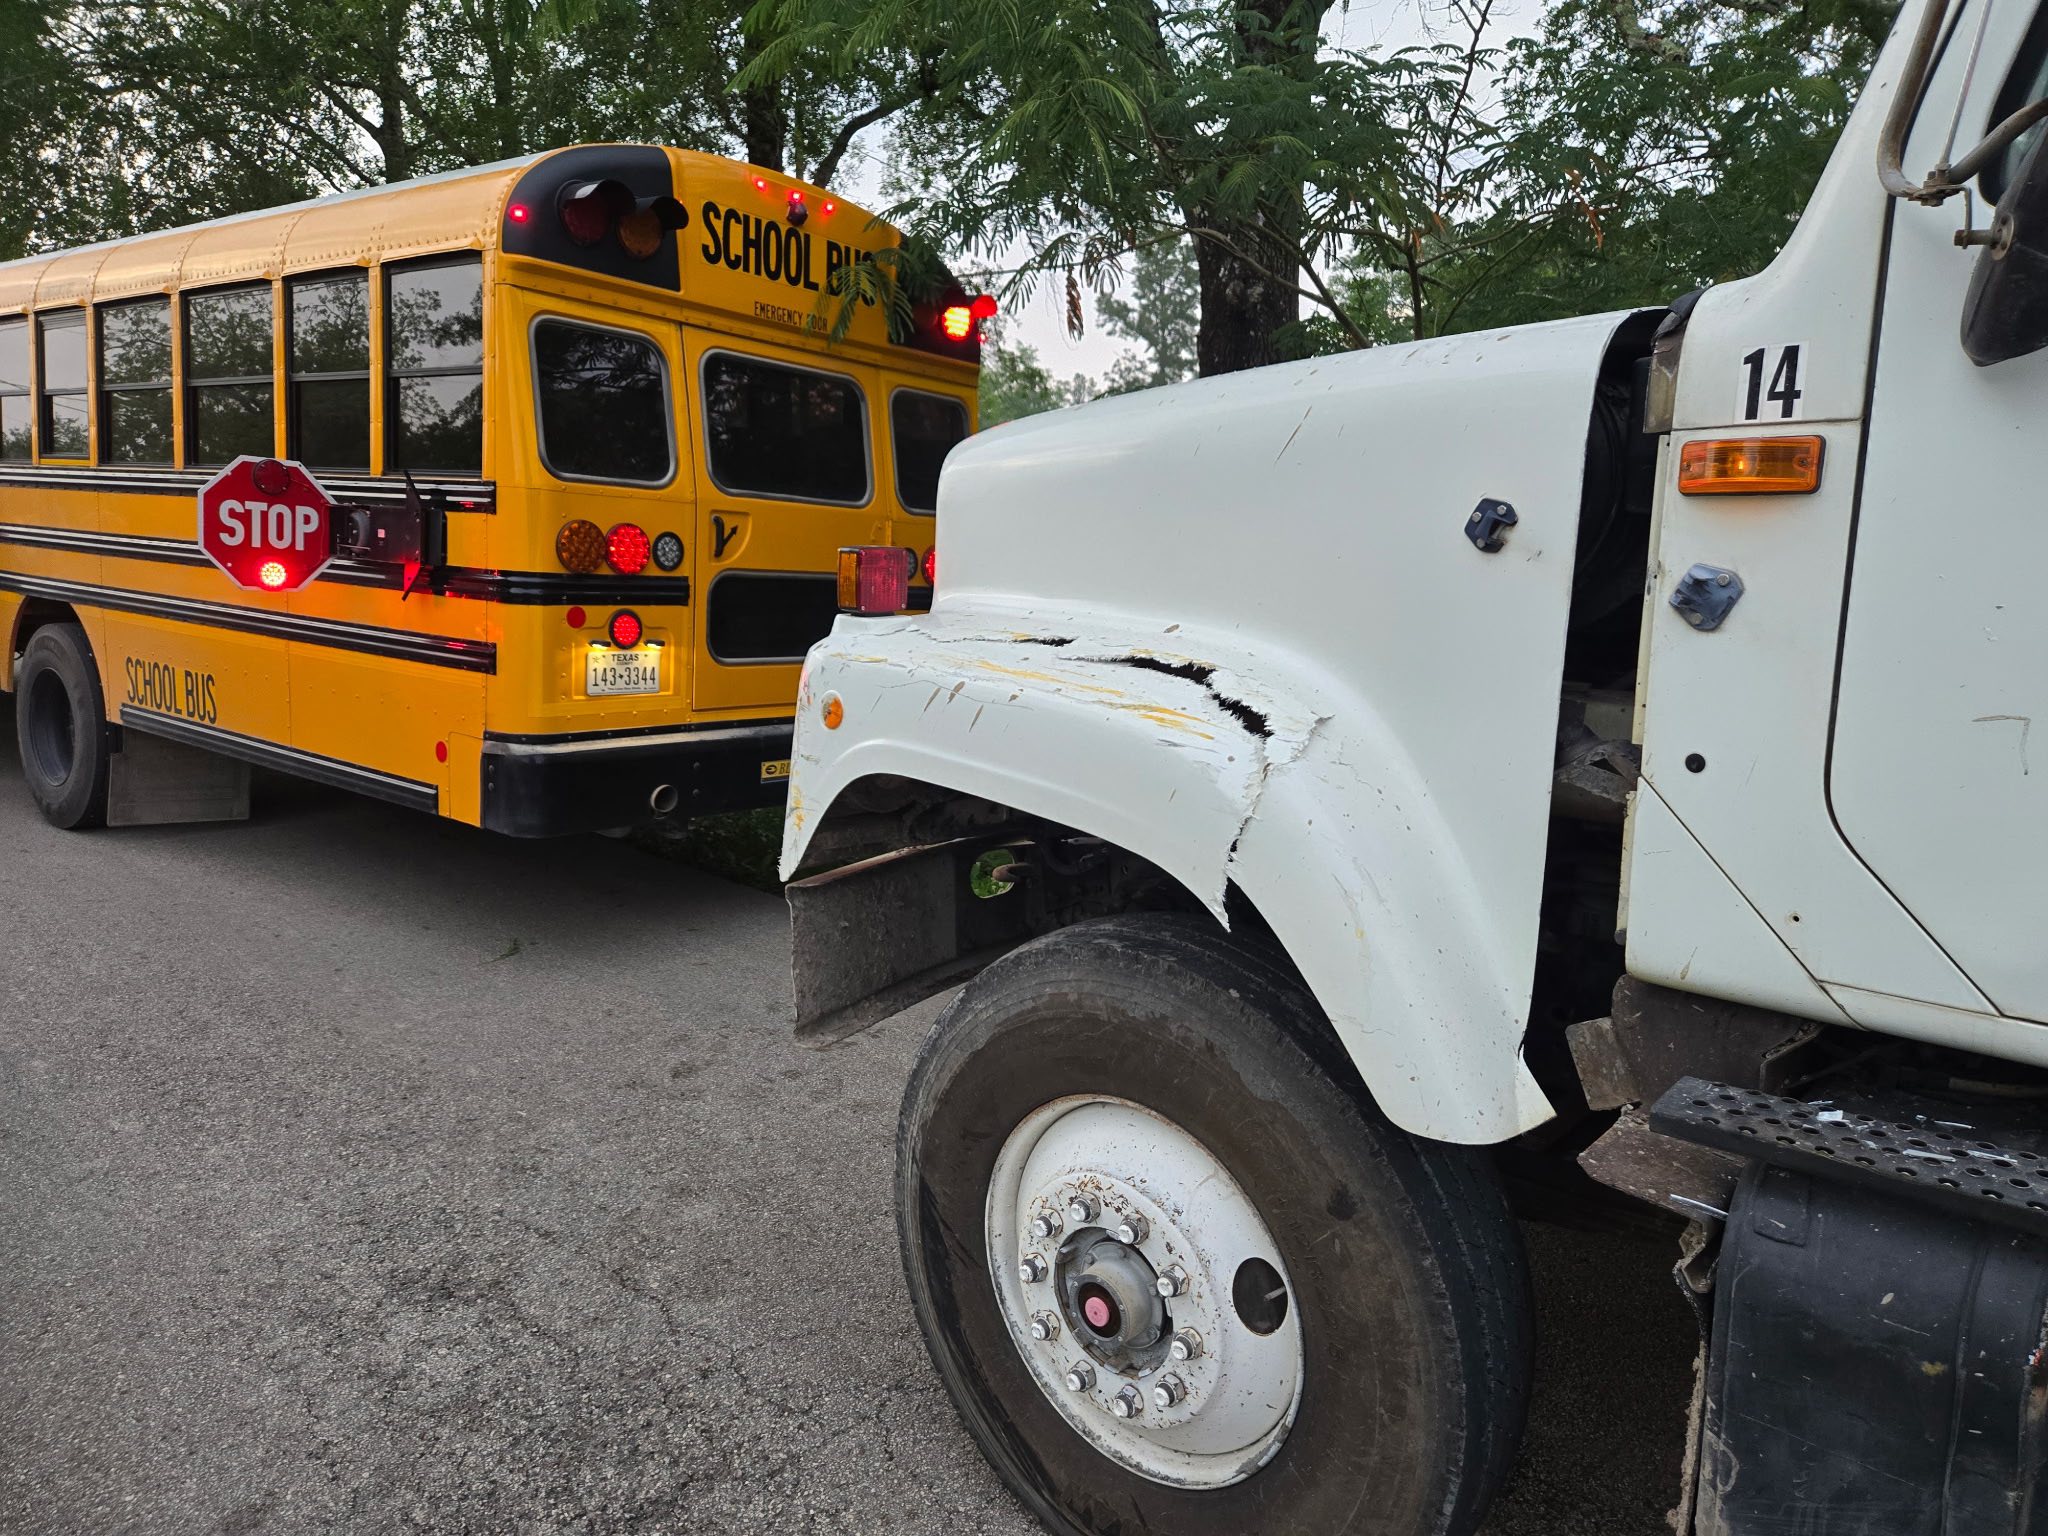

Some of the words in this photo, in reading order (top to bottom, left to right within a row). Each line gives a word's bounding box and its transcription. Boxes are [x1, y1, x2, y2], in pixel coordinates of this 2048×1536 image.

[702, 201, 819, 292] SCHOOL
[754, 301, 803, 326] EMERGENCY
[1743, 345, 1802, 420] 14
[219, 499, 319, 551] STOP
[611, 653, 640, 662] TEXAS
[126, 656, 182, 715] SCHOOL
[184, 670, 217, 724] BUS
